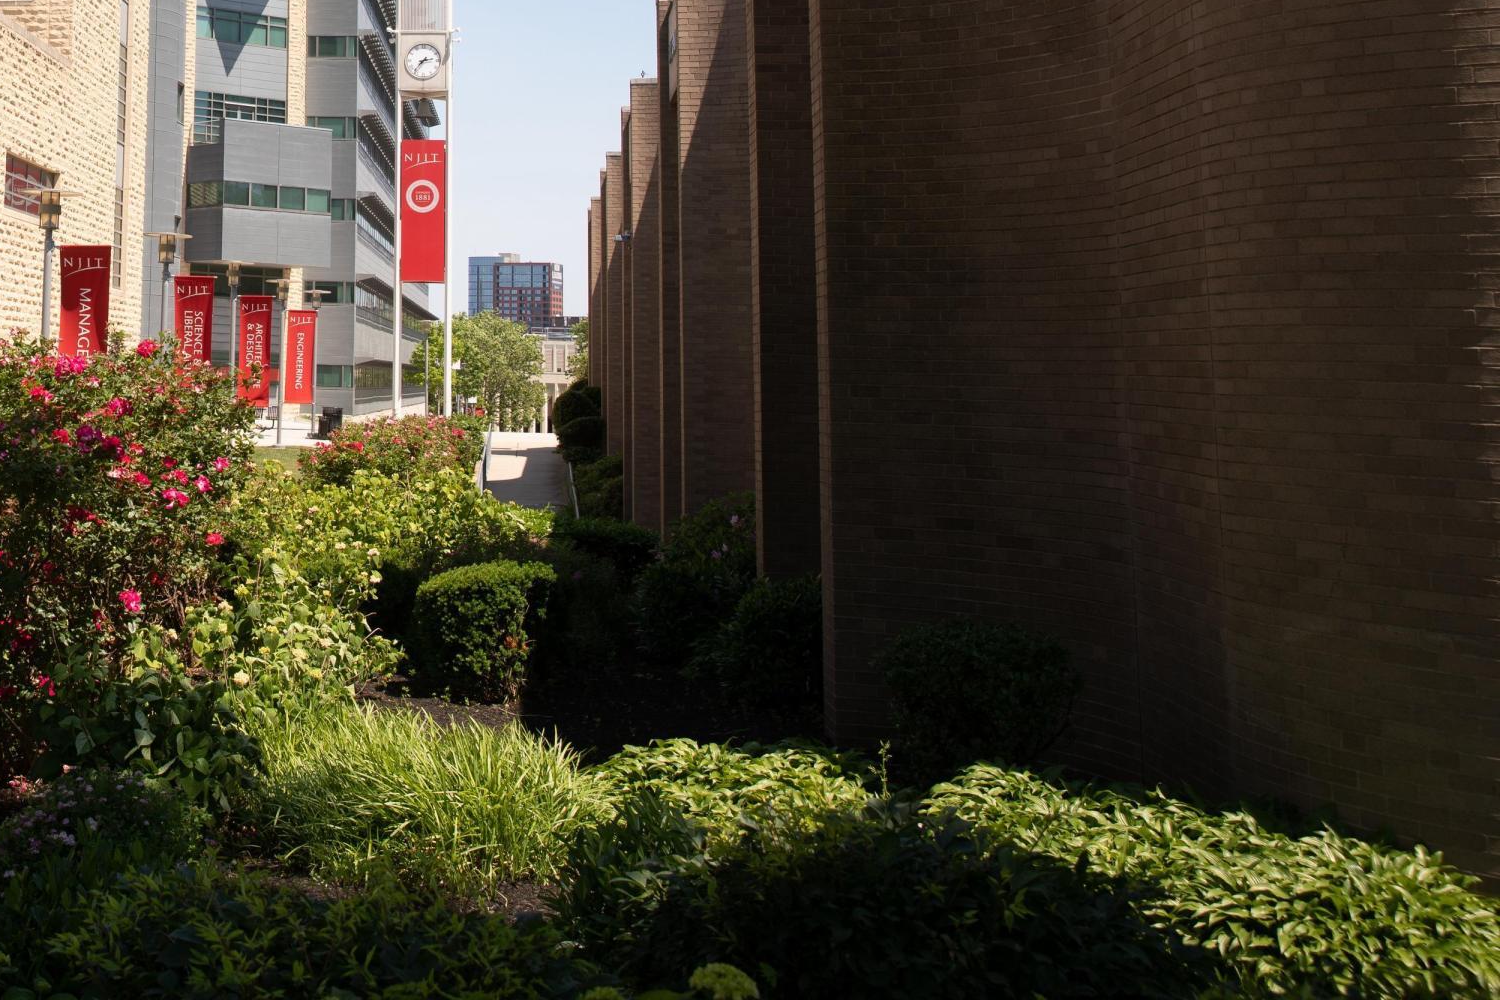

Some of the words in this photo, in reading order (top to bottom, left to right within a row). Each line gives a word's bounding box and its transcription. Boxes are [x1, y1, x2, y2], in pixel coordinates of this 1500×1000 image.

[404, 153, 439, 163] NJIT
[63, 257, 104, 270] NJIT
[177, 285, 208, 296] NJIT
[242, 303, 268, 311] NJIT
[183, 310, 193, 350] LIBERAL
[290, 316, 312, 324] NJIT
[193, 311, 204, 355] SCIENCE
[245, 333, 254, 367] DESIGN
[253, 323, 263, 389] ARCHITECRE
[294, 332, 305, 390] ENGINEERING
